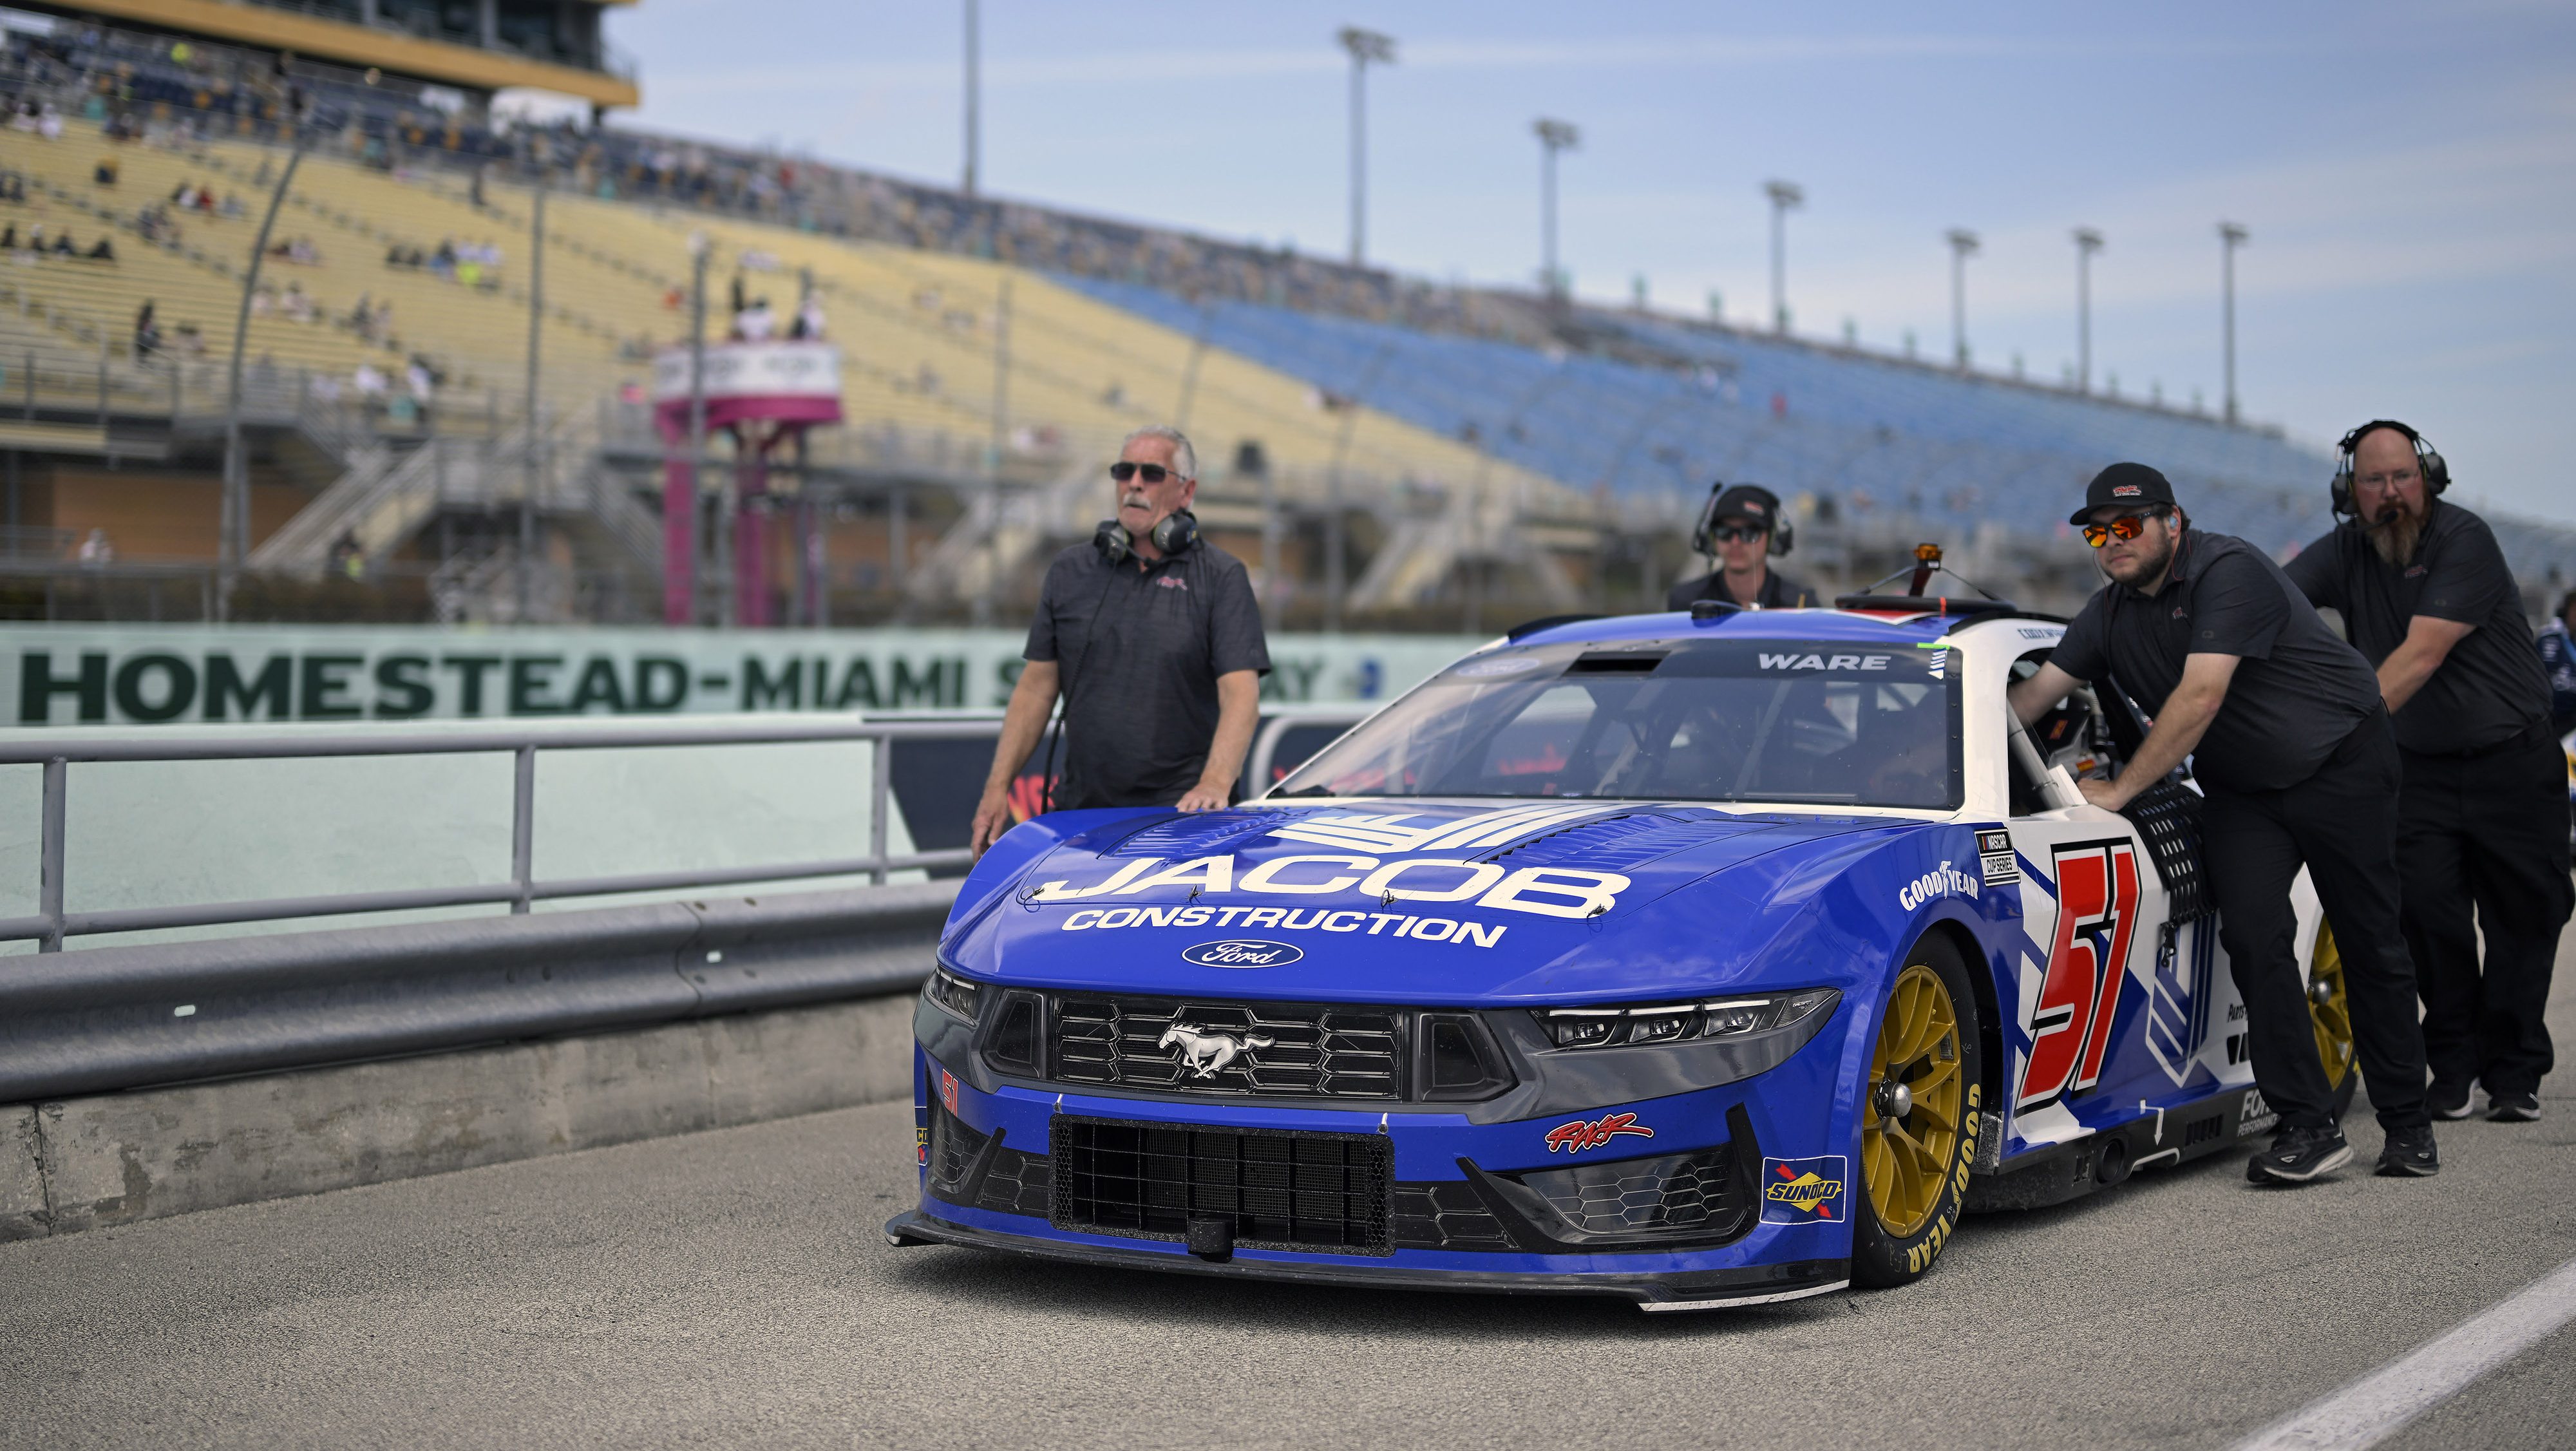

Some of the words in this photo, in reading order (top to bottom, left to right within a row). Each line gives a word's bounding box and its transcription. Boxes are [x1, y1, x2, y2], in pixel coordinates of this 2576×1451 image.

[1759, 653, 1892, 670] WARE
[19, 652, 967, 723] HOMESTEAD-MIAMI
[1988, 835, 2007, 849] NASCAR
[1987, 858, 1997, 873] CUP
[1997, 857, 2012, 873] SERIES
[1039, 855, 1631, 919] JACOB
[1061, 906, 1507, 948] CONSTRUCTION
[1201, 942, 1283, 964] Ford
[2016, 840, 2141, 1114] 51
[942, 1068, 958, 1117] 51
[2240, 1088, 2272, 1122] FO
[1545, 1113, 1654, 1153] RWR
[1768, 1182, 1840, 1200] SUNOCO
